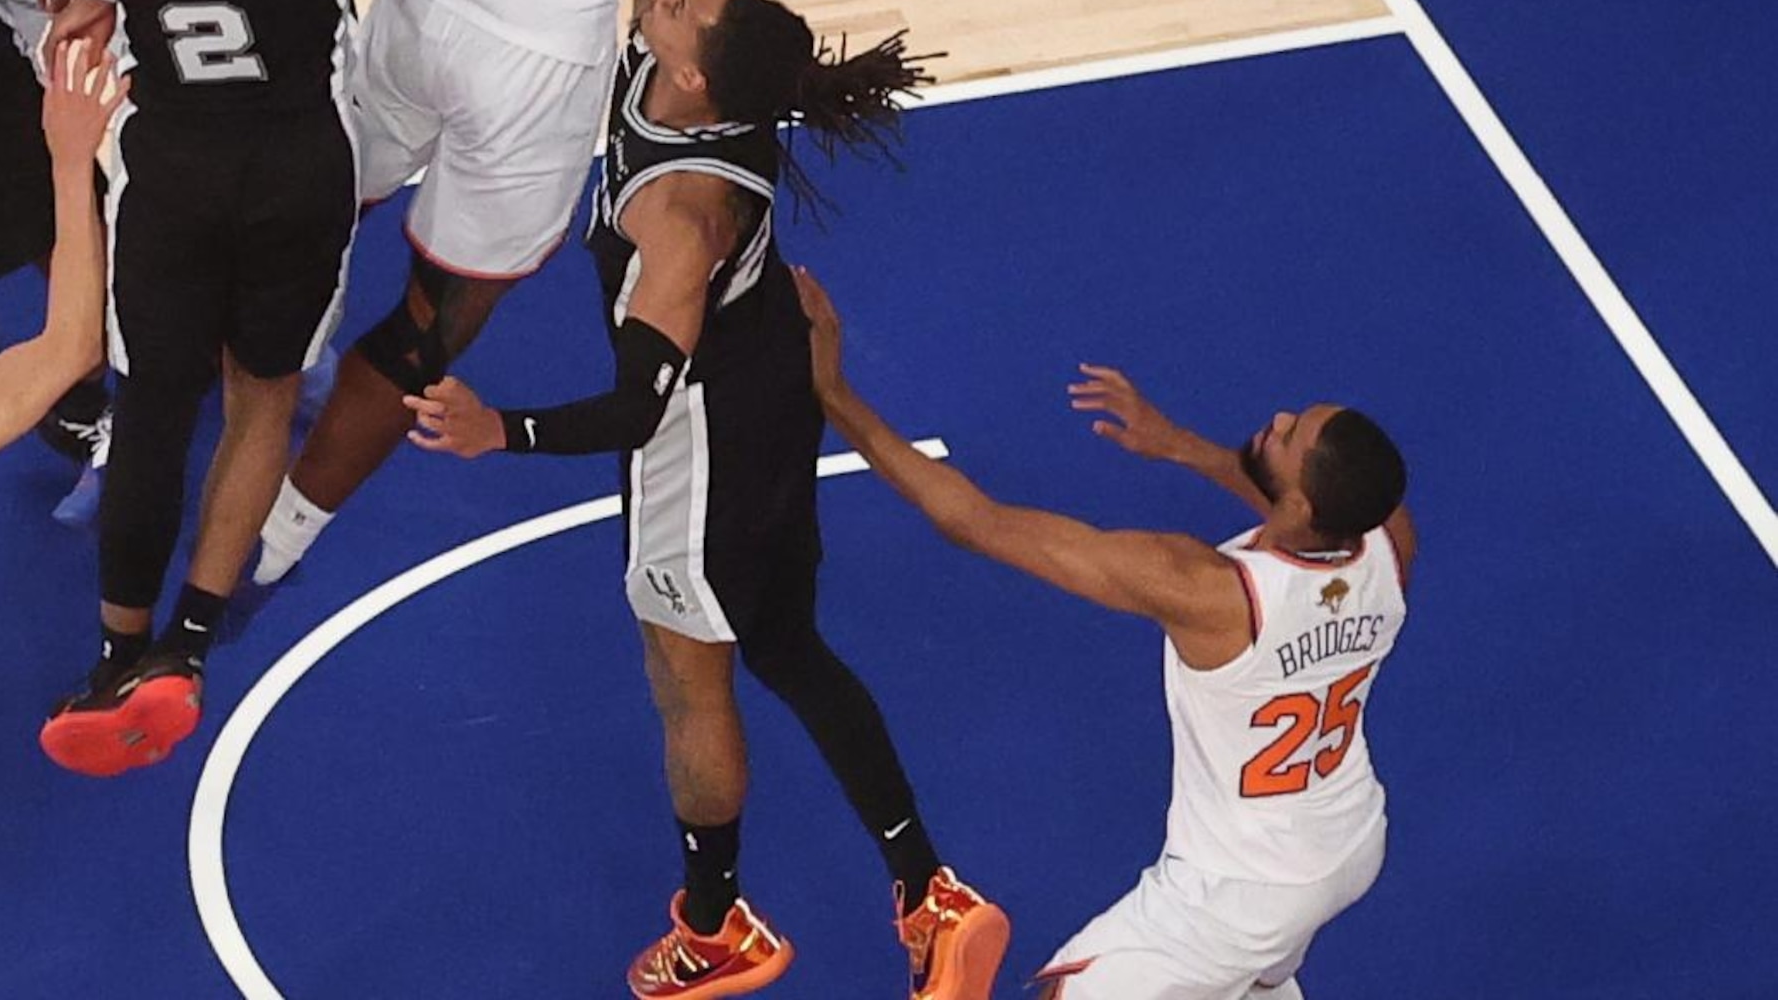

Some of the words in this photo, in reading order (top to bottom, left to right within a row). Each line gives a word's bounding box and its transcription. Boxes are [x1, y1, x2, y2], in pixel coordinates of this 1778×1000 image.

[158, 1, 269, 84] 2
[1275, 614, 1384, 679] BRIDGES
[1239, 659, 1377, 798] 25
